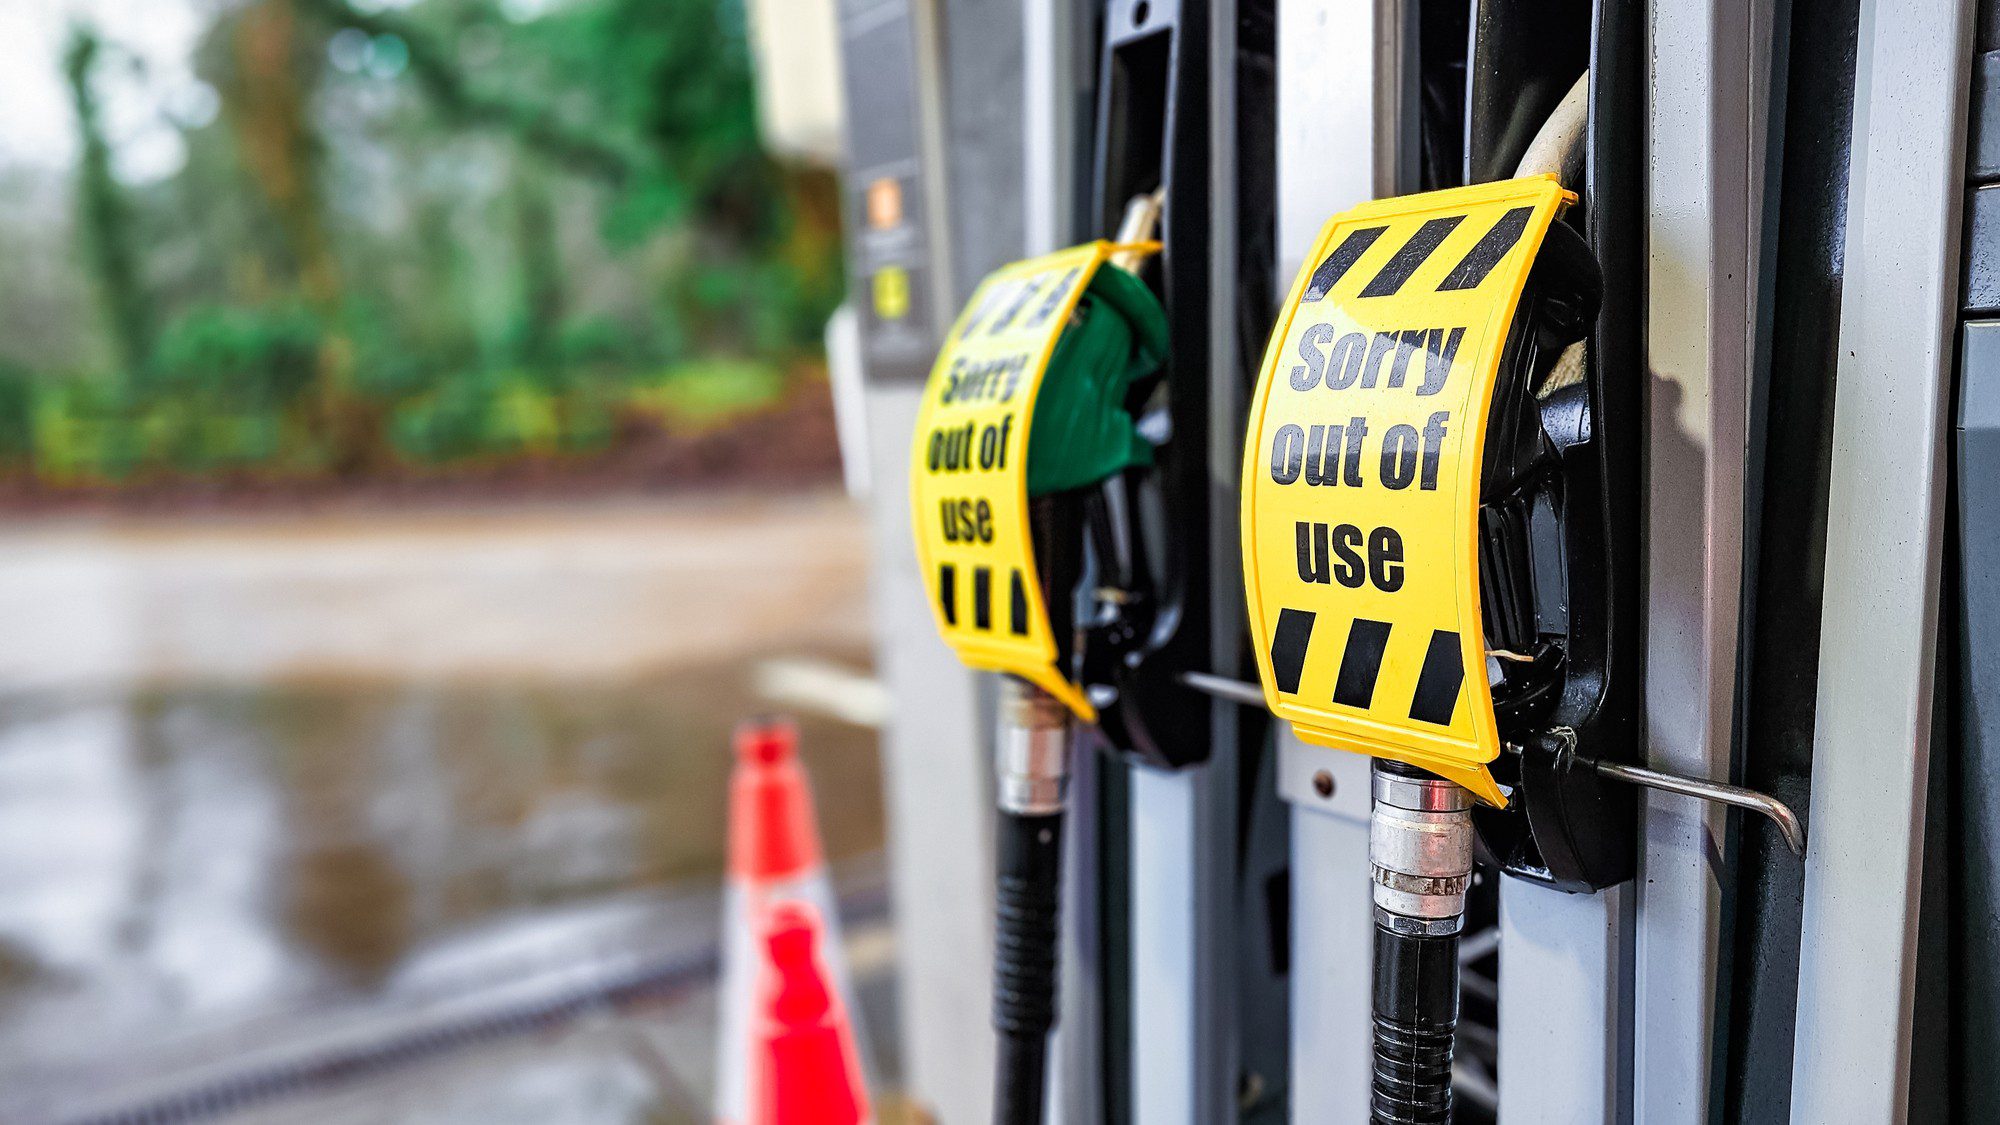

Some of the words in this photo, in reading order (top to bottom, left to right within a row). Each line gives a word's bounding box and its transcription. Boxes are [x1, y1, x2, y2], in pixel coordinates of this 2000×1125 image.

[942, 354, 1030, 407] Sorry
[1289, 322, 1467, 396] Sorry
[928, 421, 974, 472] out
[979, 414, 1013, 472] of
[1270, 416, 1369, 488] out
[1379, 411, 1450, 491] of
[940, 497, 994, 545] use
[1295, 521, 1405, 593] use
